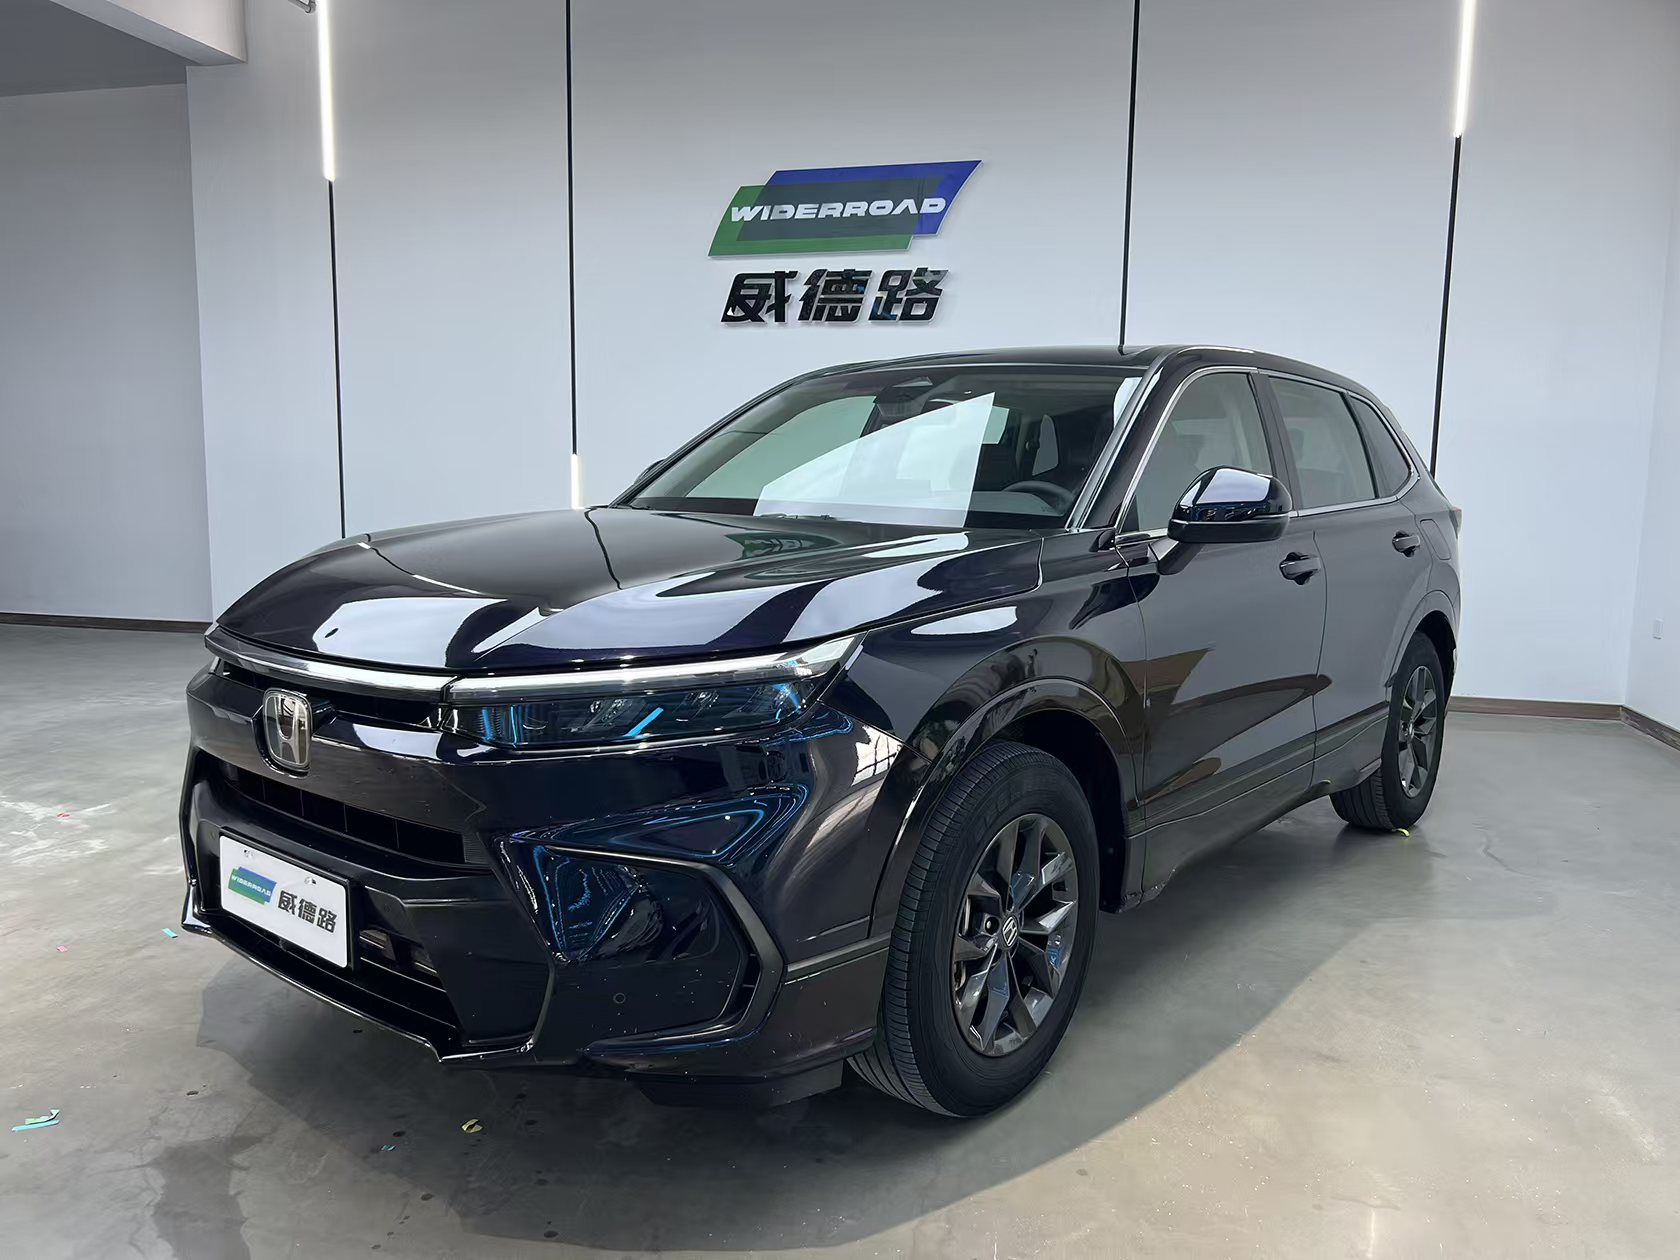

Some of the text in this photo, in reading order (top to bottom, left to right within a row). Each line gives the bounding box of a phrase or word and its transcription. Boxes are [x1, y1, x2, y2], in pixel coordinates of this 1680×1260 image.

[731, 198, 946, 222] WIDERROAD
[721, 267, 949, 323] 威德路
[231, 874, 271, 897] WIDERROAD
[278, 890, 337, 933] 威德路
